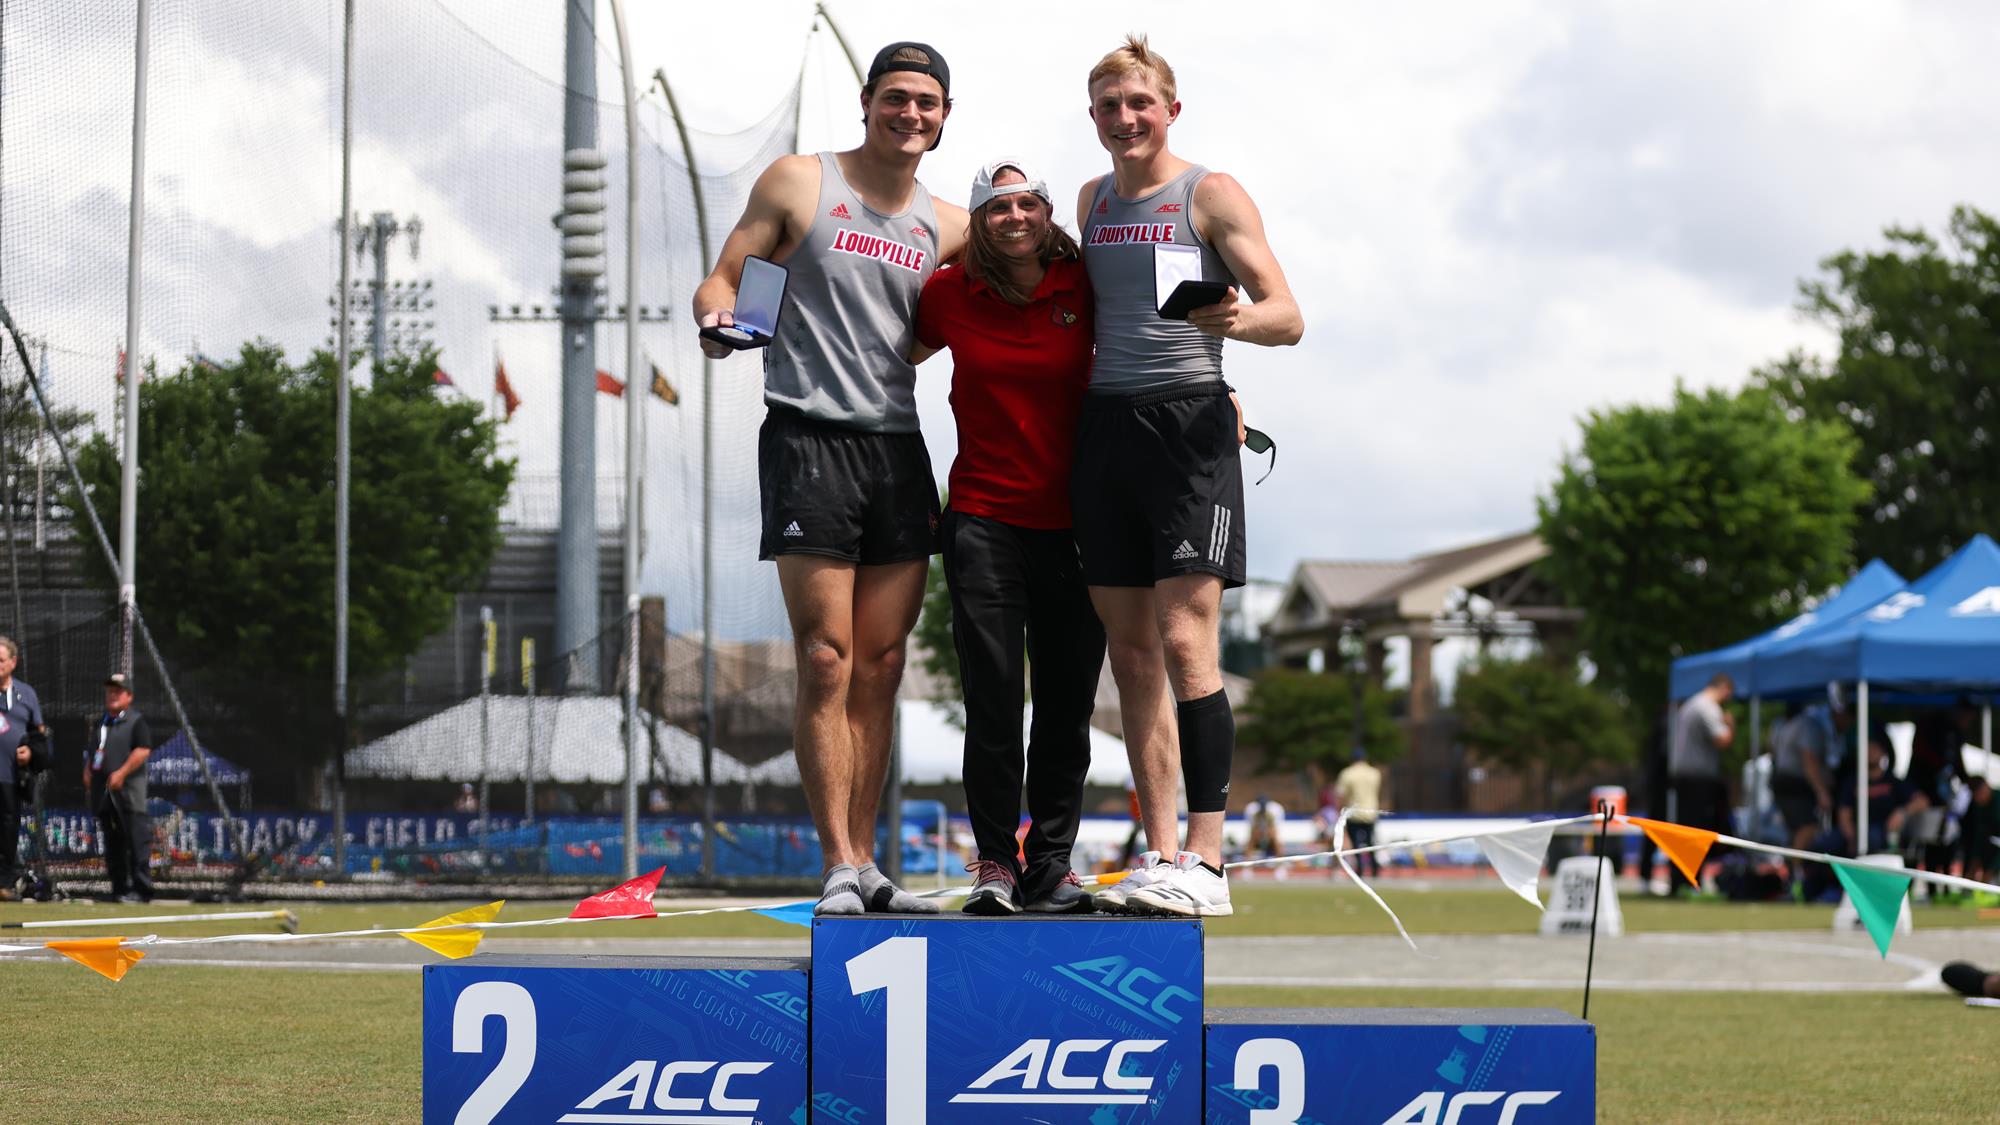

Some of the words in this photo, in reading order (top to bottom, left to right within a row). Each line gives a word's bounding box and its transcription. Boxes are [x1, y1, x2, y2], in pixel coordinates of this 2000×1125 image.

[1155, 203, 1184, 214] ACC
[831, 228, 926, 274] LOUISVILLE
[1088, 222, 1177, 246] LOUISVILLE
[1172, 551, 1199, 560] adidas
[693, 989, 746, 1031] COAST
[1067, 955, 1200, 1024] ACC
[453, 981, 537, 1125] 2
[845, 937, 927, 1125] 1
[574, 1060, 774, 1111] ACC
[968, 1039, 1168, 1090] ACC
[1378, 1091, 1562, 1125] ACC
